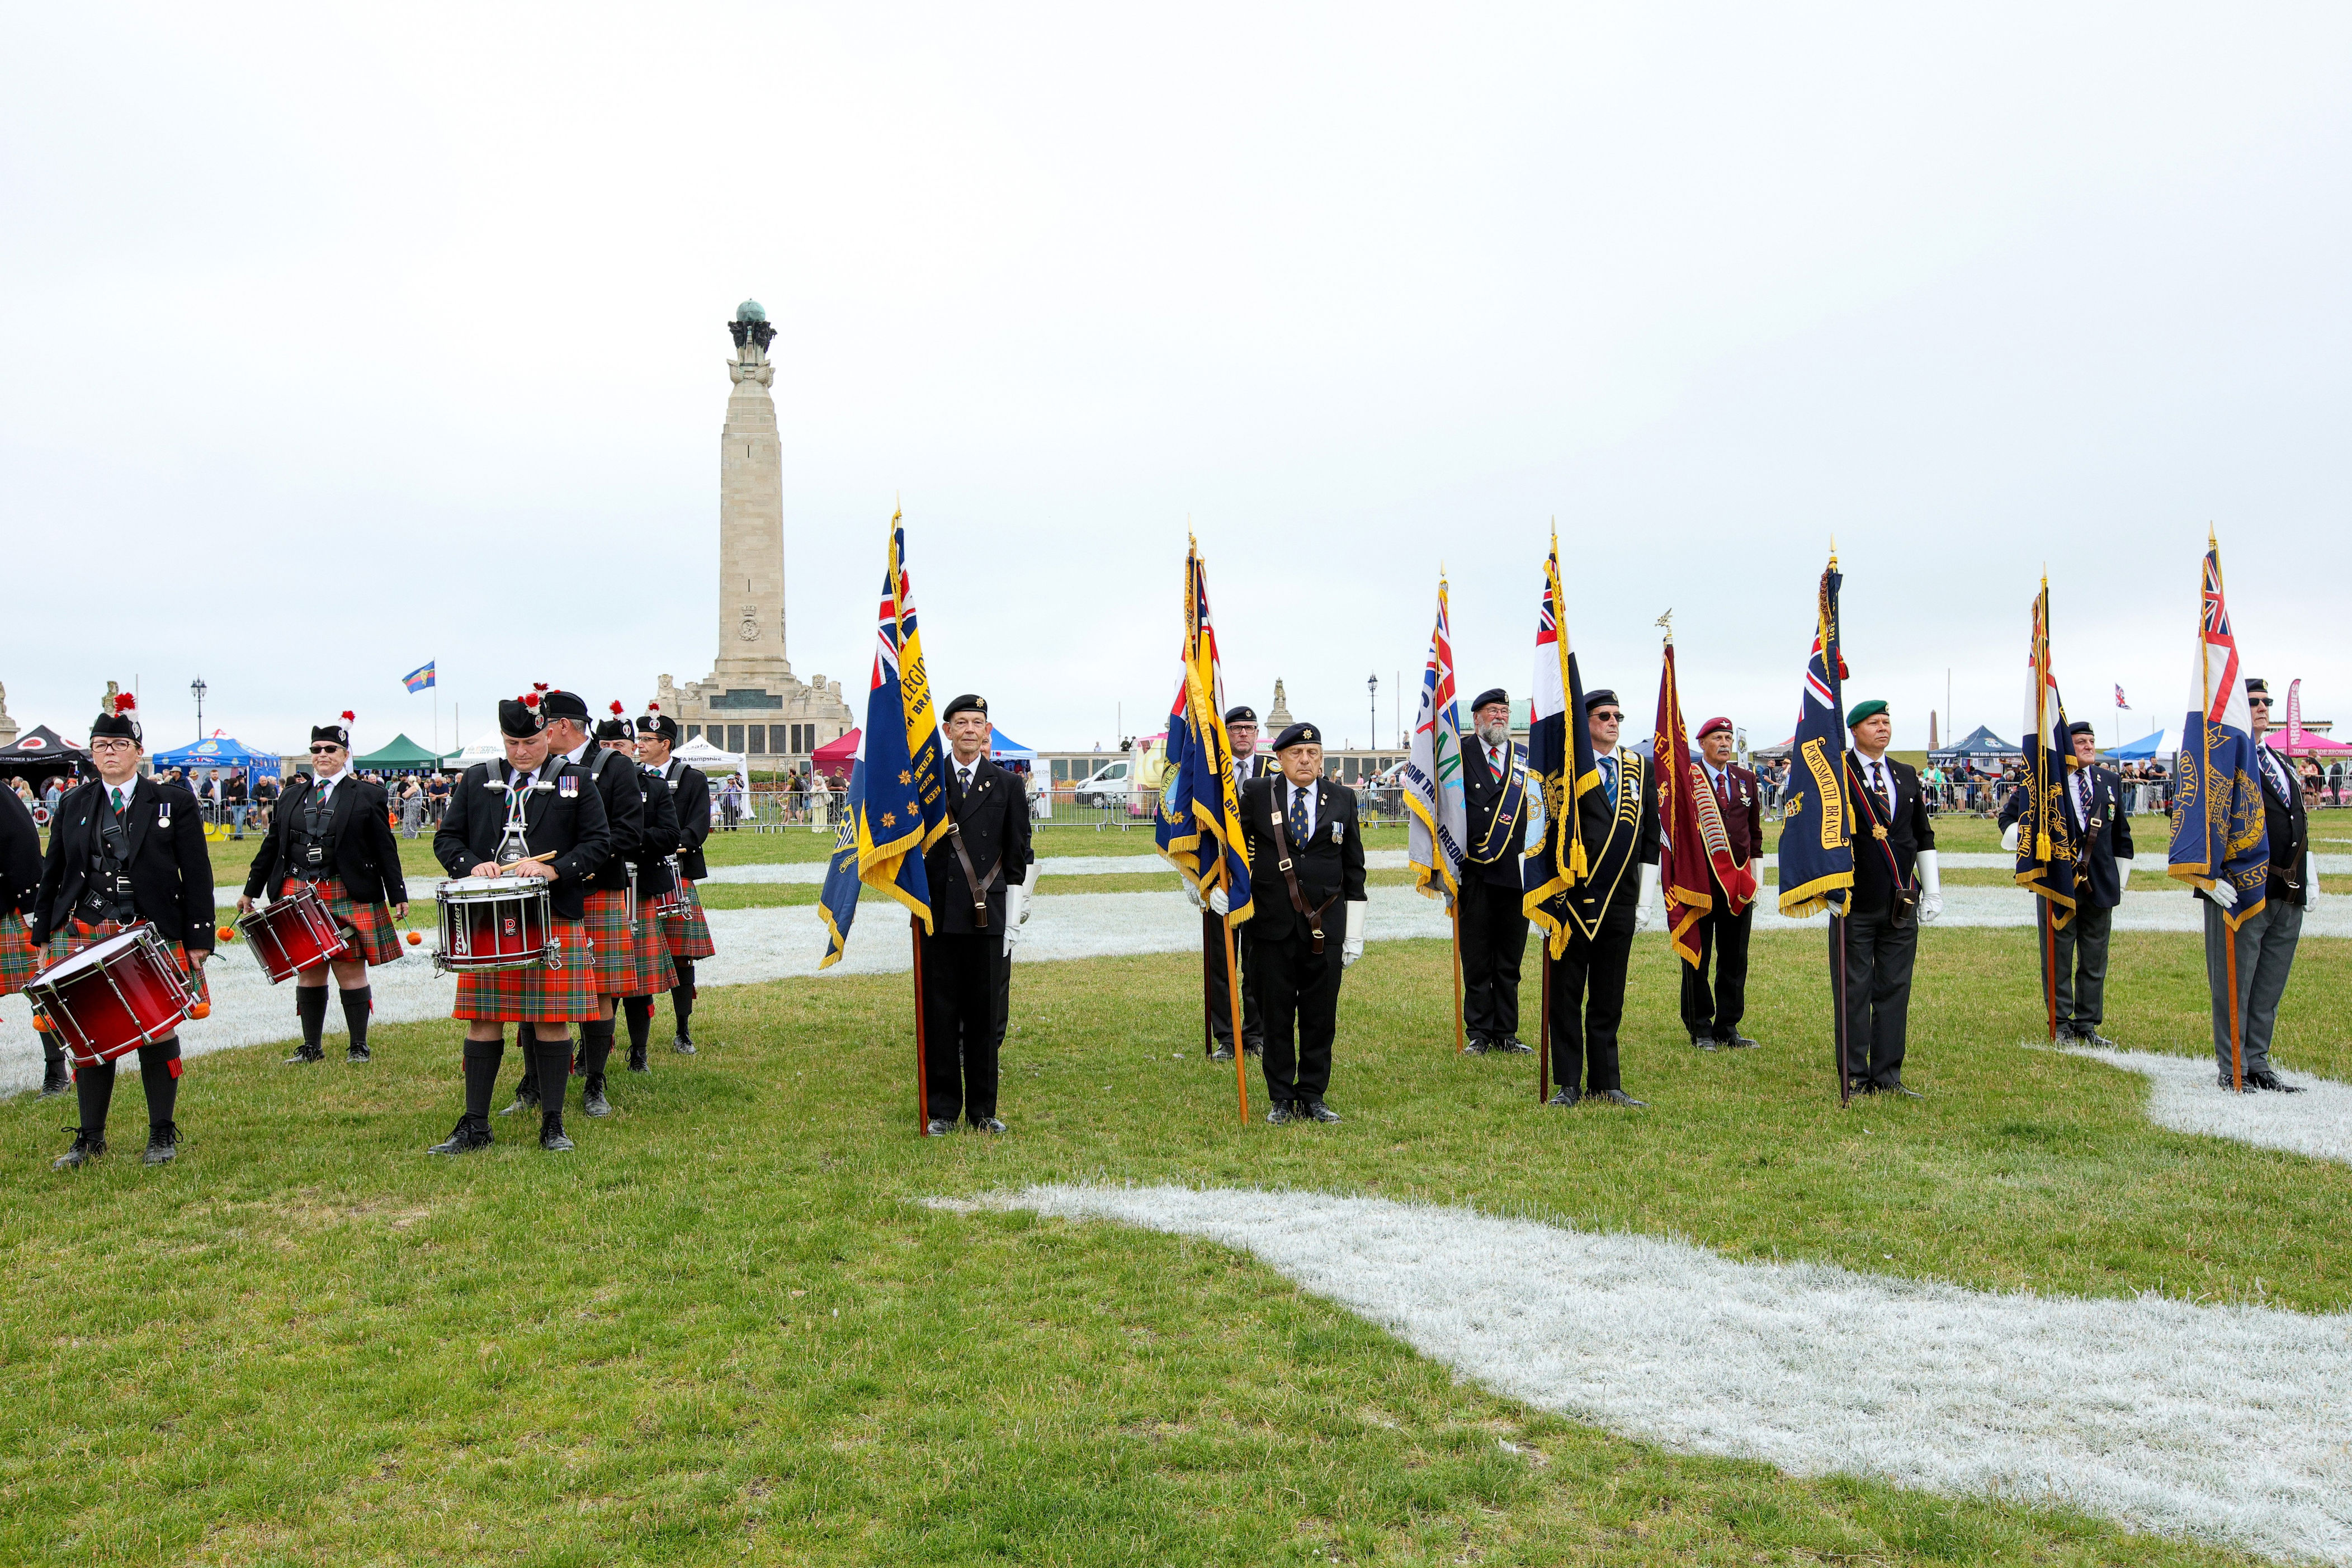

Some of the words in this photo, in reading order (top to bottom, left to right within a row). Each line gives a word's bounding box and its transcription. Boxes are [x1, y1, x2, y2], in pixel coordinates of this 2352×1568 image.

[903, 653, 927, 702] LEGIO
[918, 757, 930, 774] CUP
[2179, 755, 2193, 802] ROYAL
[921, 776, 932, 790] 1921
[927, 788, 939, 802] 1927
[1161, 776, 1172, 792] TYPE
[1804, 744, 1838, 800] PORTSMOUTH
[1824, 805, 1839, 843] BRANCH
[2020, 826, 2032, 856] NAVAL
[454, 904, 463, 955] Premier
